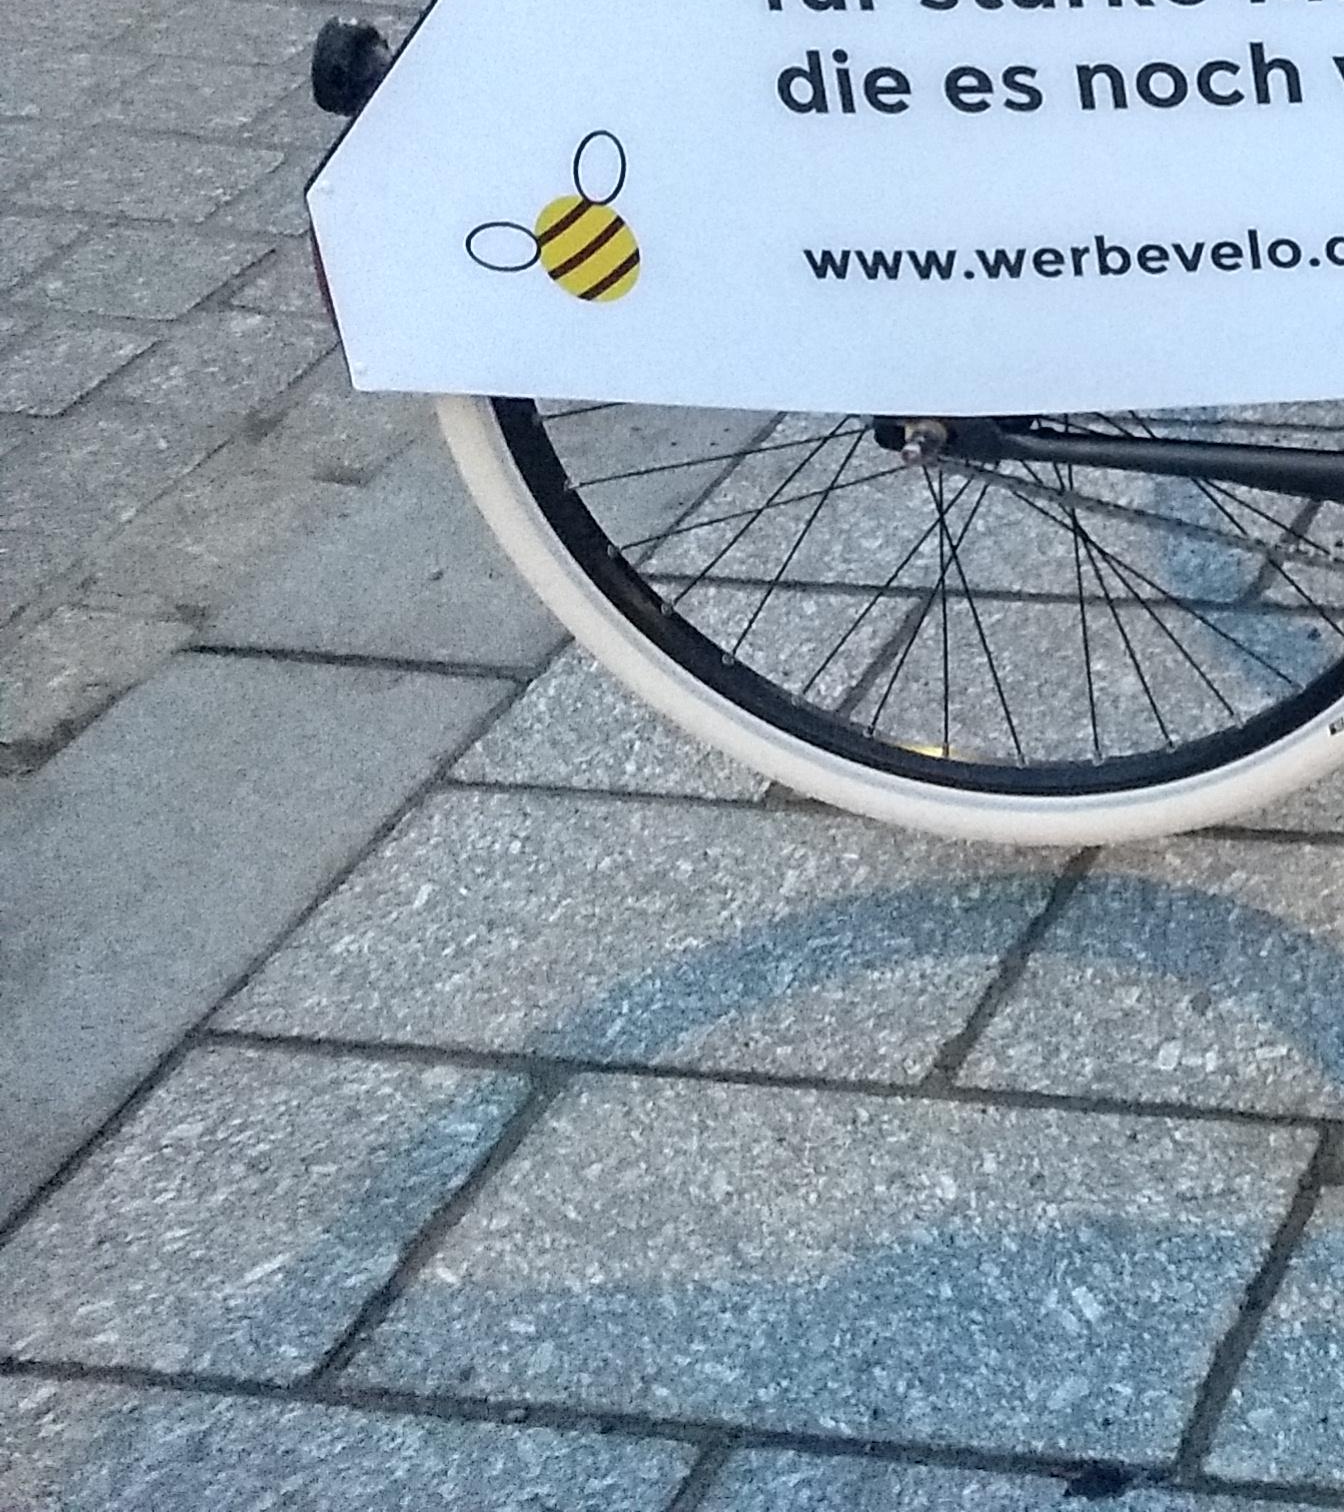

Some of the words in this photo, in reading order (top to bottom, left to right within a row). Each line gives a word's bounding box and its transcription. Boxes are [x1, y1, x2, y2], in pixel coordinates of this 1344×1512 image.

[777, 48, 912, 114] die
[944, 65, 1043, 113] es
[1075, 41, 1303, 110] noch
